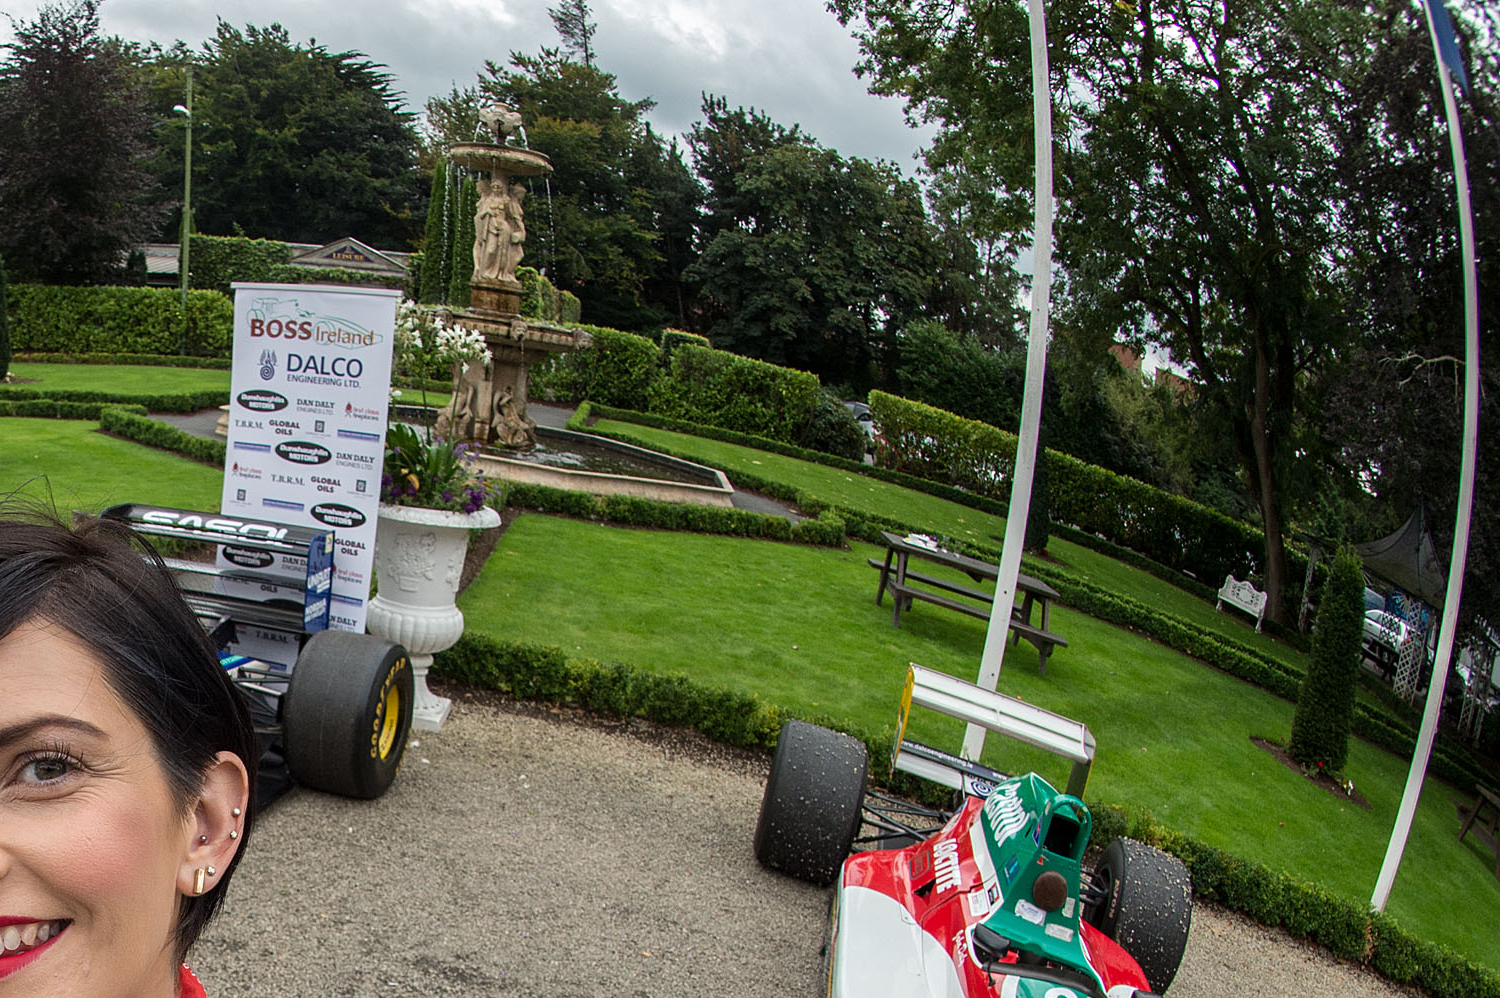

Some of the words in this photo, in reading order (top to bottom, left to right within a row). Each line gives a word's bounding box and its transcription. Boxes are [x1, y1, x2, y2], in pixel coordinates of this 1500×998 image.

[250, 318, 312, 340] BOSS
[316, 326, 375, 346] Ireland
[286, 353, 363, 378] DALCO
[286, 374, 342, 387] ENGINEERING
[343, 377, 361, 389] LTD.
[296, 398, 314, 407] DAN
[315, 400, 336, 409] DALY
[269, 419, 300, 430] GLOBAL
[275, 427, 293, 436] OILS
[335, 452, 353, 461] DAN
[353, 454, 375, 464] DALY
[311, 475, 342, 487] GLOBAL
[317, 484, 335, 493] OILS
[142, 510, 293, 548] SASOL
[335, 538, 366, 550] GLOBAL
[340, 547, 358, 557] OILS
[282, 556, 299, 565] DAN
[260, 584, 278, 593] OILS
[337, 617, 358, 627] DALY
[370, 657, 406, 759] GOODYEAR
[984, 782, 1030, 847] Castrol
[933, 838, 962, 894] LOCTITE
